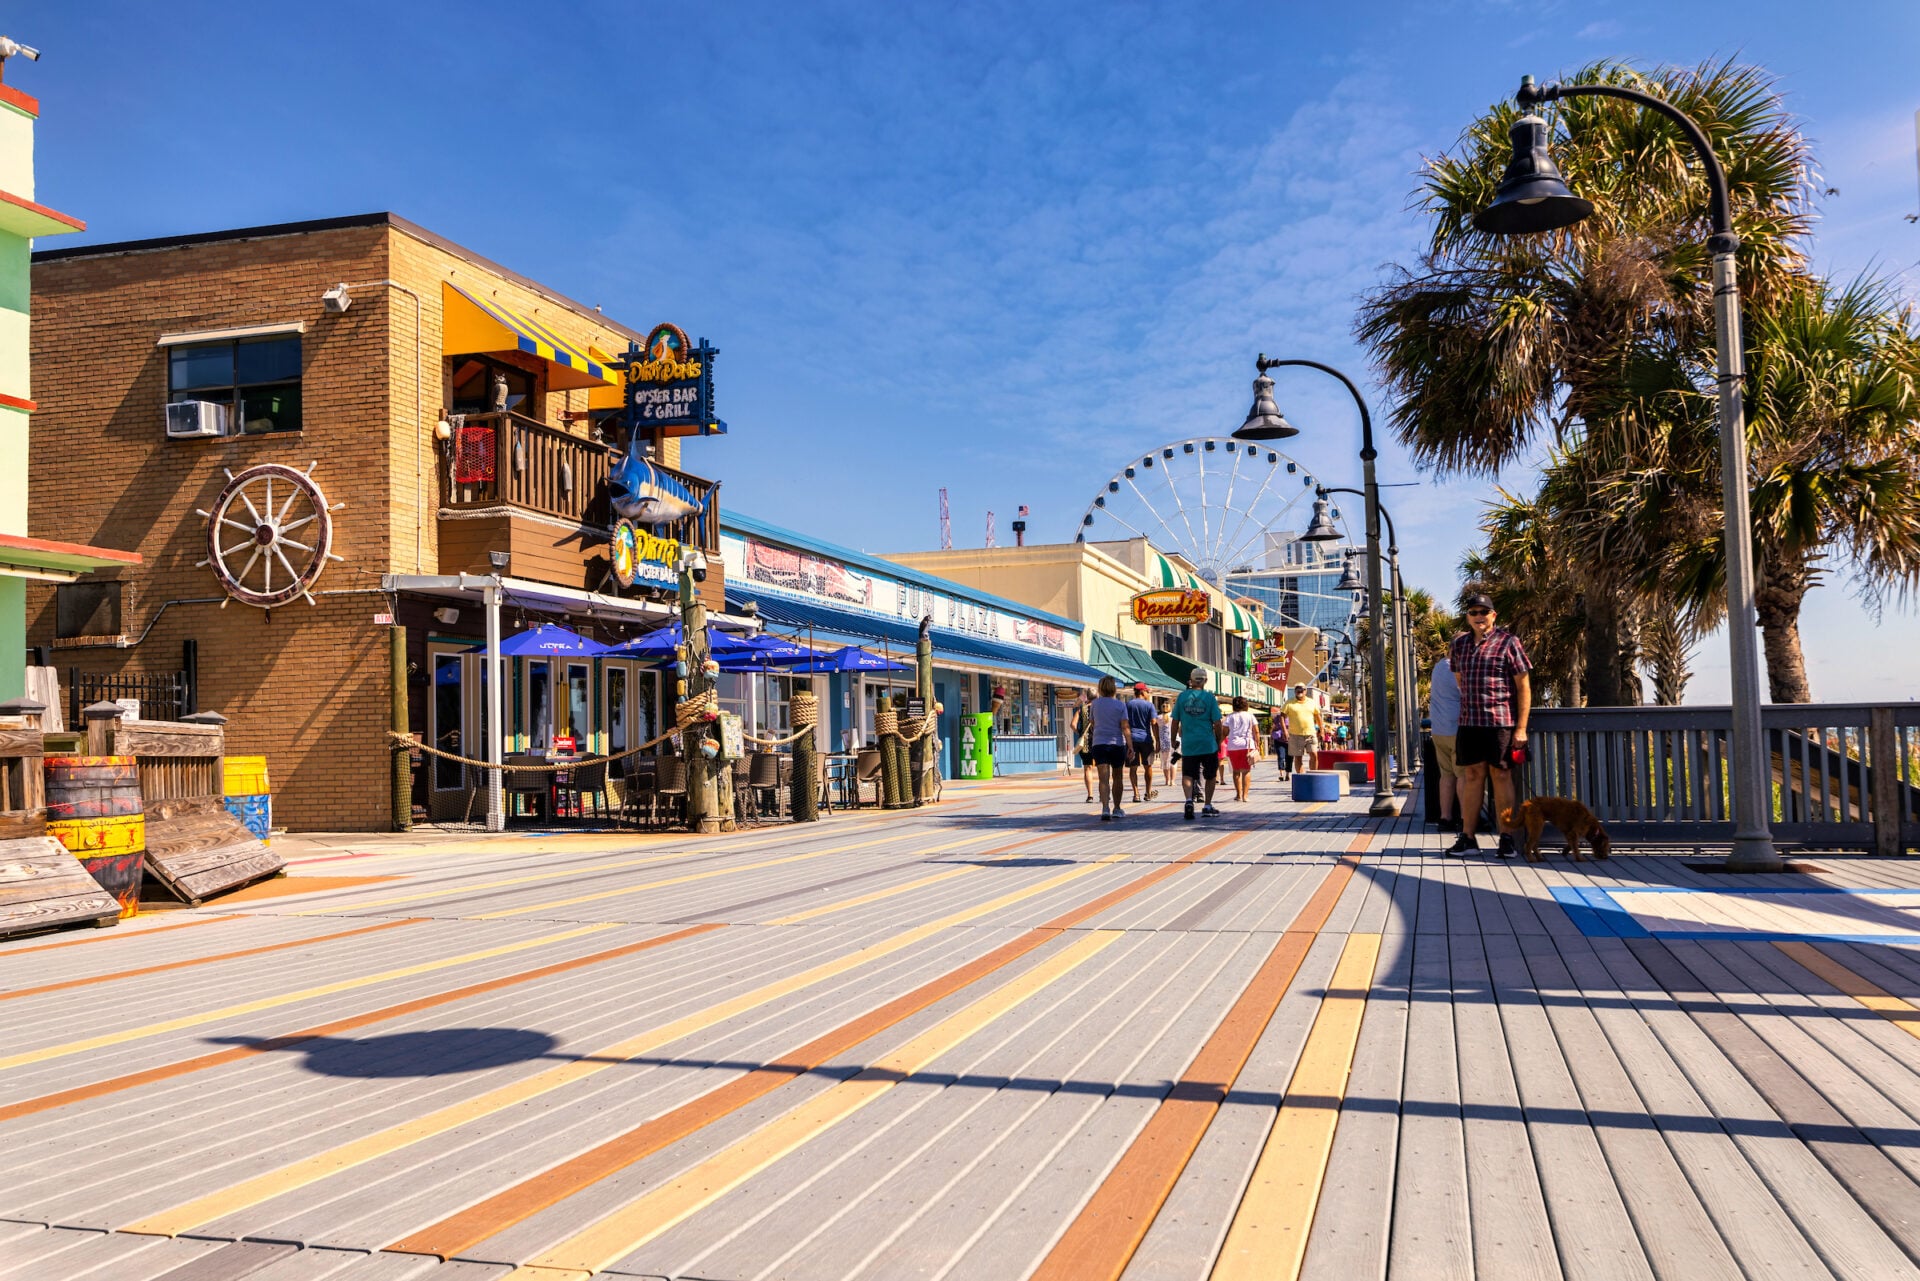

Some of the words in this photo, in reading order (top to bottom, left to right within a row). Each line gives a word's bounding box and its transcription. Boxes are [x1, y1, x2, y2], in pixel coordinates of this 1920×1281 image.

[635, 389, 670, 405] OYSTER
[673, 386, 698, 403] BAR
[643, 405, 653, 418] &
[655, 402, 691, 419] GRILL
[897, 580, 935, 619] FUN
[948, 595, 999, 638] PLAZA
[1137, 594, 1207, 620] Paradise
[376, 614, 392, 623] ATM
[961, 718, 977, 726] ATM
[961, 726, 978, 776] ATM
